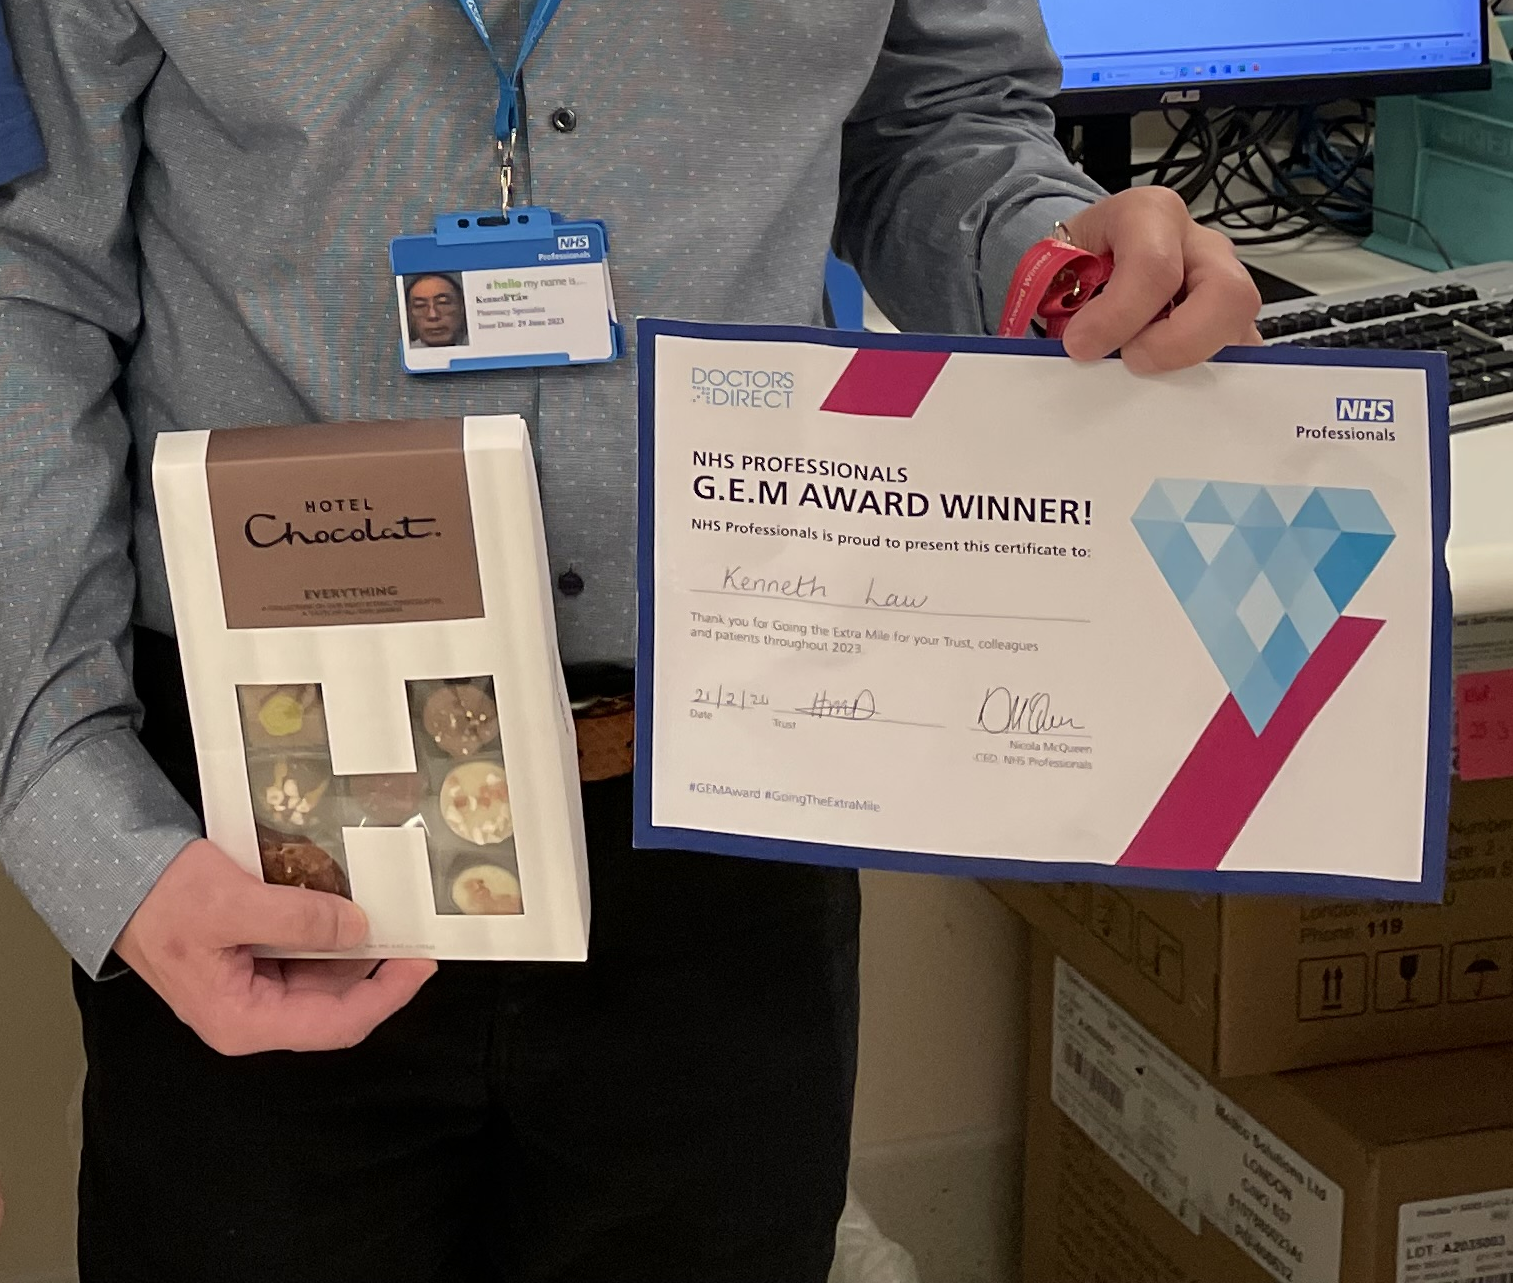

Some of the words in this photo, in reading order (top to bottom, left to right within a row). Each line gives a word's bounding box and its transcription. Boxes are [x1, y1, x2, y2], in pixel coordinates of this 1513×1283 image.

[559, 236, 588, 249] NHS
[537, 251, 591, 261] Professionals
[523, 279, 539, 290] my
[540, 278, 567, 287] name
[691, 367, 795, 389] DOCTORS
[712, 388, 794, 409] DIRECT
[1337, 399, 1393, 422] NHS
[1296, 426, 1396, 442] Professionals
[692, 451, 735, 469] NHS
[741, 454, 909, 483] PROFESSIONALS
[305, 498, 374, 513] HOTEL
[692, 475, 788, 506] G.E.M
[798, 483, 930, 517] AWARD
[939, 493, 1092, 526] WINNER!
[244, 513, 442, 548] Chocolat.
[691, 518, 721, 532] NHS
[725, 521, 818, 541] Professionals
[822, 529, 833, 542] is
[838, 534, 881, 549] proud
[886, 537, 901, 549] to
[905, 538, 960, 552] present
[963, 539, 990, 552] this
[994, 541, 1067, 557] certificate
[1071, 546, 1092, 558] to:
[303, 585, 399, 601] EVERYTHING
[722, 566, 827, 598] Kenneth
[864, 578, 929, 608] Law
[690, 611, 725, 625] Thank
[728, 616, 750, 629] you
[753, 616, 769, 629] for
[772, 620, 808, 636] Going
[811, 623, 830, 636] the
[833, 626, 862, 640] Extra
[865, 629, 890, 642] Mile
[894, 631, 911, 643] for
[913, 635, 940, 646] your
[944, 636, 975, 649] Trust,
[977, 638, 1039, 654] colleagues
[690, 627, 712, 640] and
[715, 630, 761, 645] patients
[763, 633, 828, 652] throughout
[689, 708, 713, 720] Date
[772, 718, 797, 730] Trust
[1008, 740, 1041, 751] Nicola
[1043, 742, 1093, 754] McQueen
[1003, 755, 1026, 766] NHS
[1028, 756, 1093, 770] Professionals
[688, 782, 761, 800] #GEMAward
[764, 789, 881, 813] #GoingTheExtraMile
